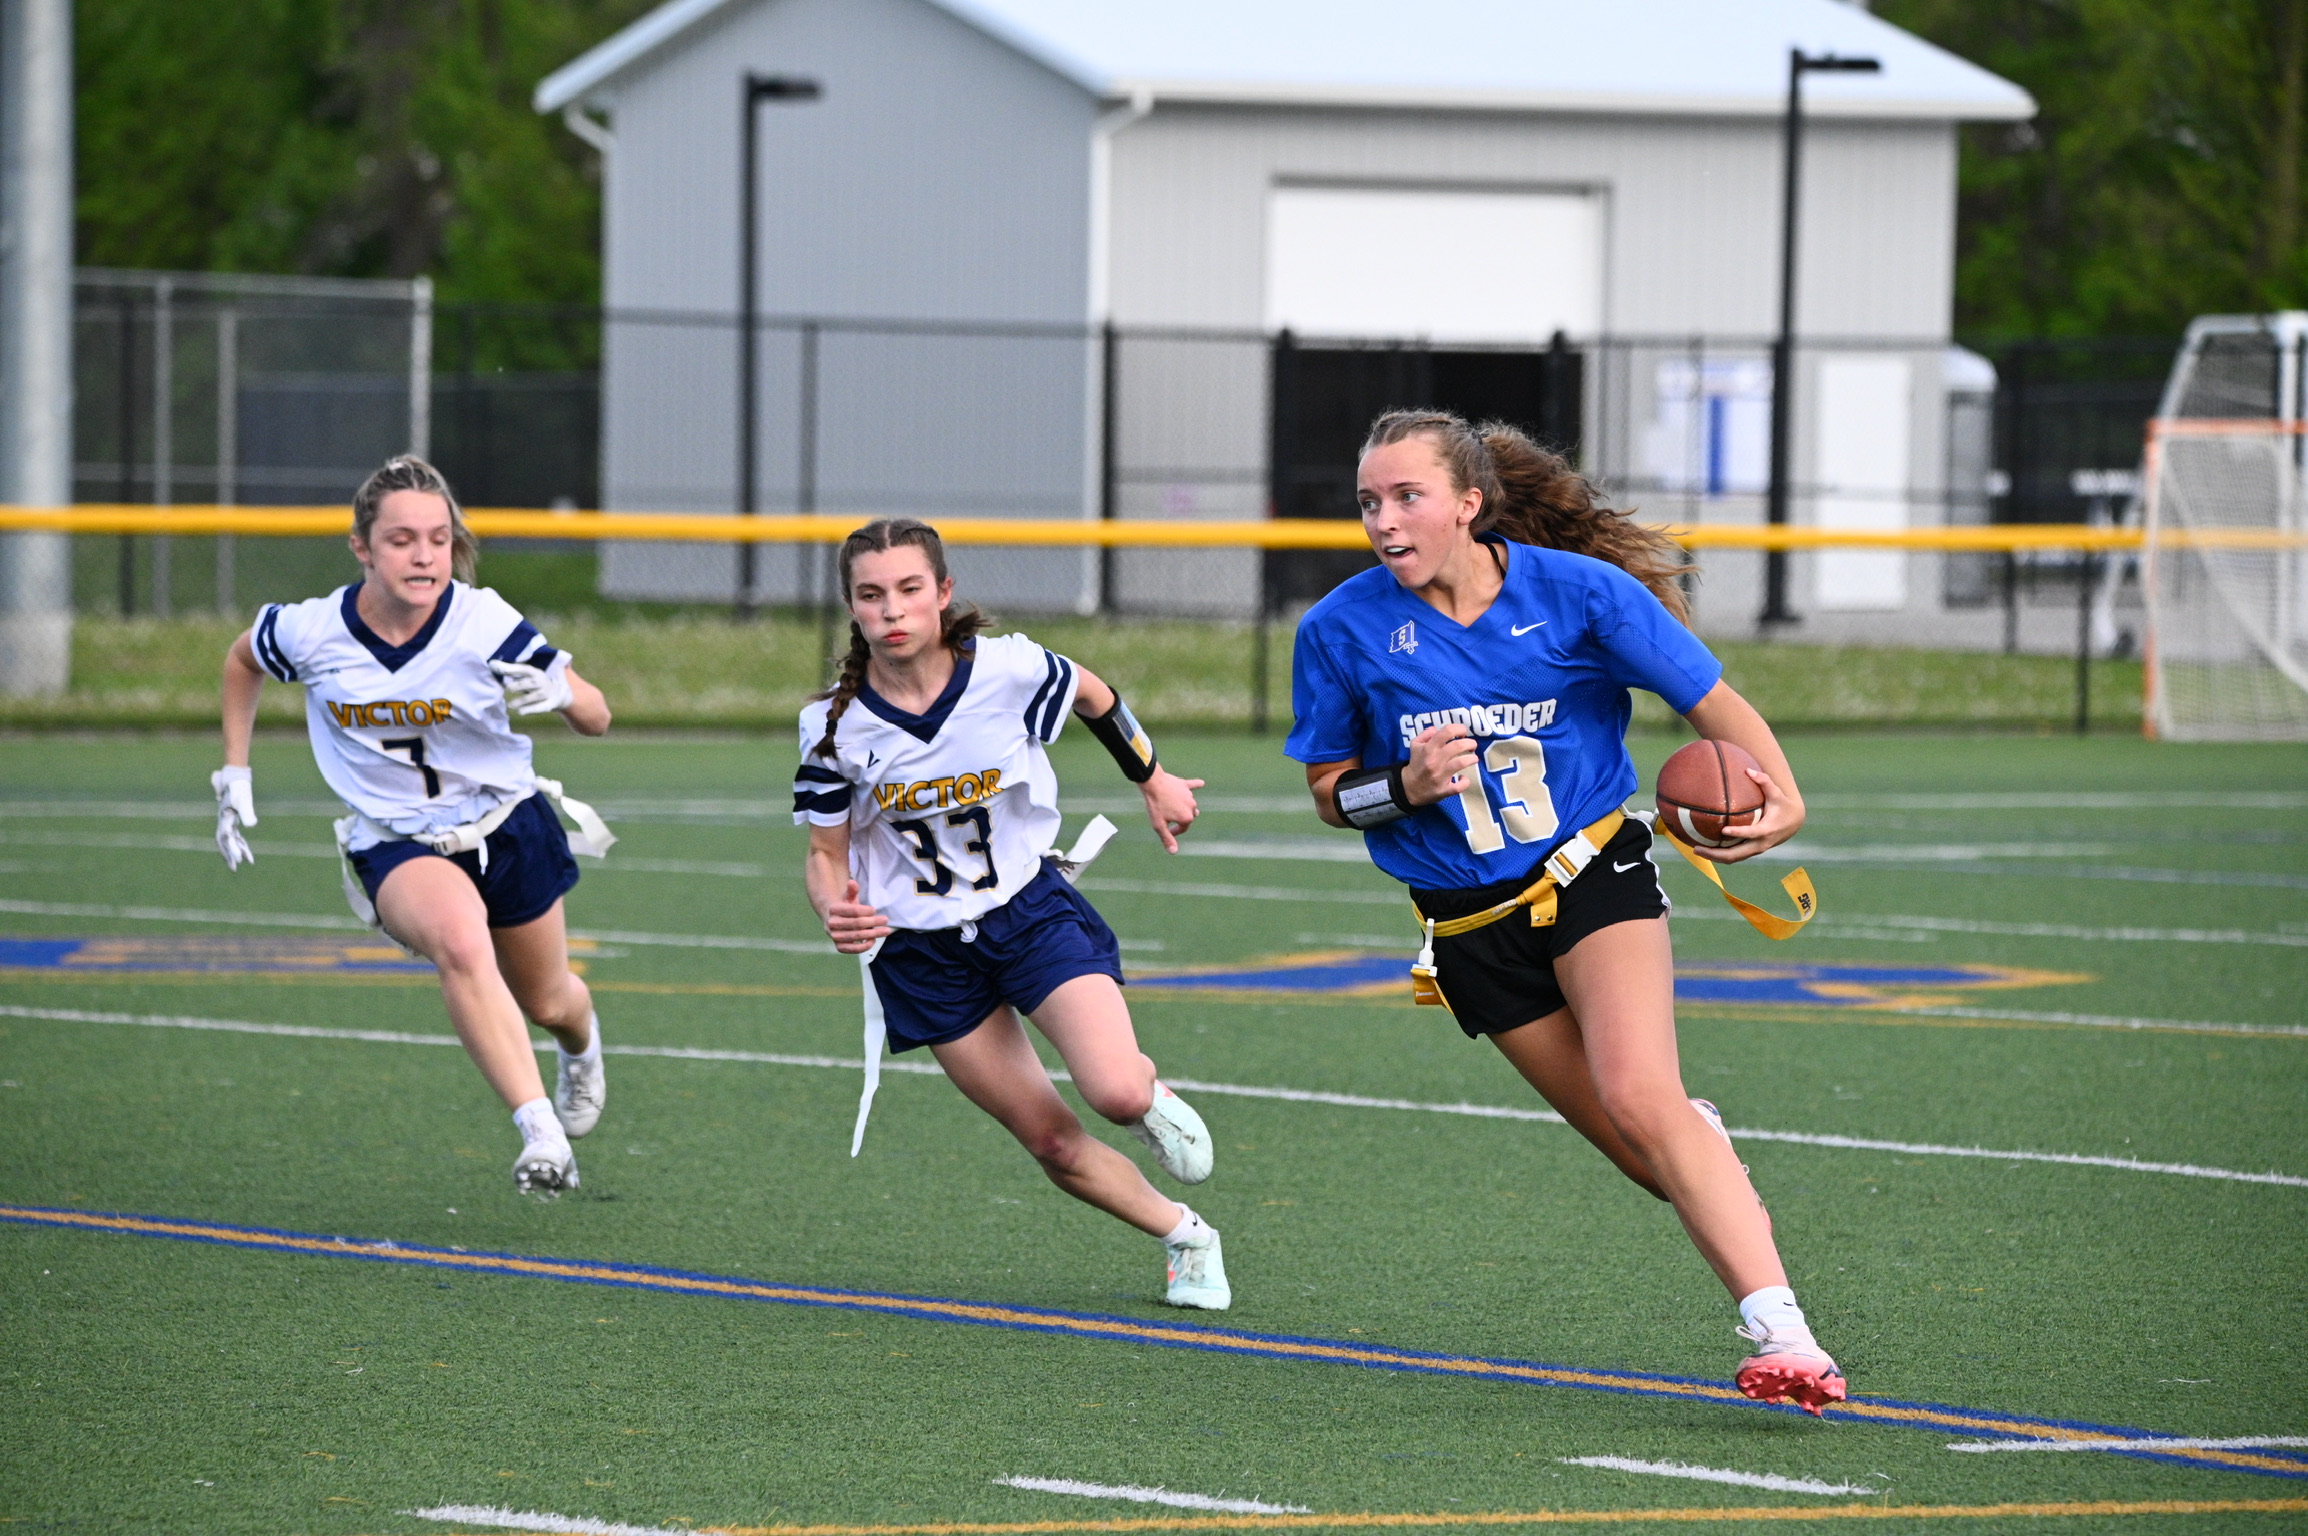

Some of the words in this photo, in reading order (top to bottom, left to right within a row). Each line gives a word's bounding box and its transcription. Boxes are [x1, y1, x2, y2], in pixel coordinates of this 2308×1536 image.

[327, 699, 452, 727] VICTOR
[382, 737, 440, 799] 7
[873, 769, 1004, 811] VICTOR
[1452, 736, 1560, 854] 13
[890, 804, 998, 897] 33
